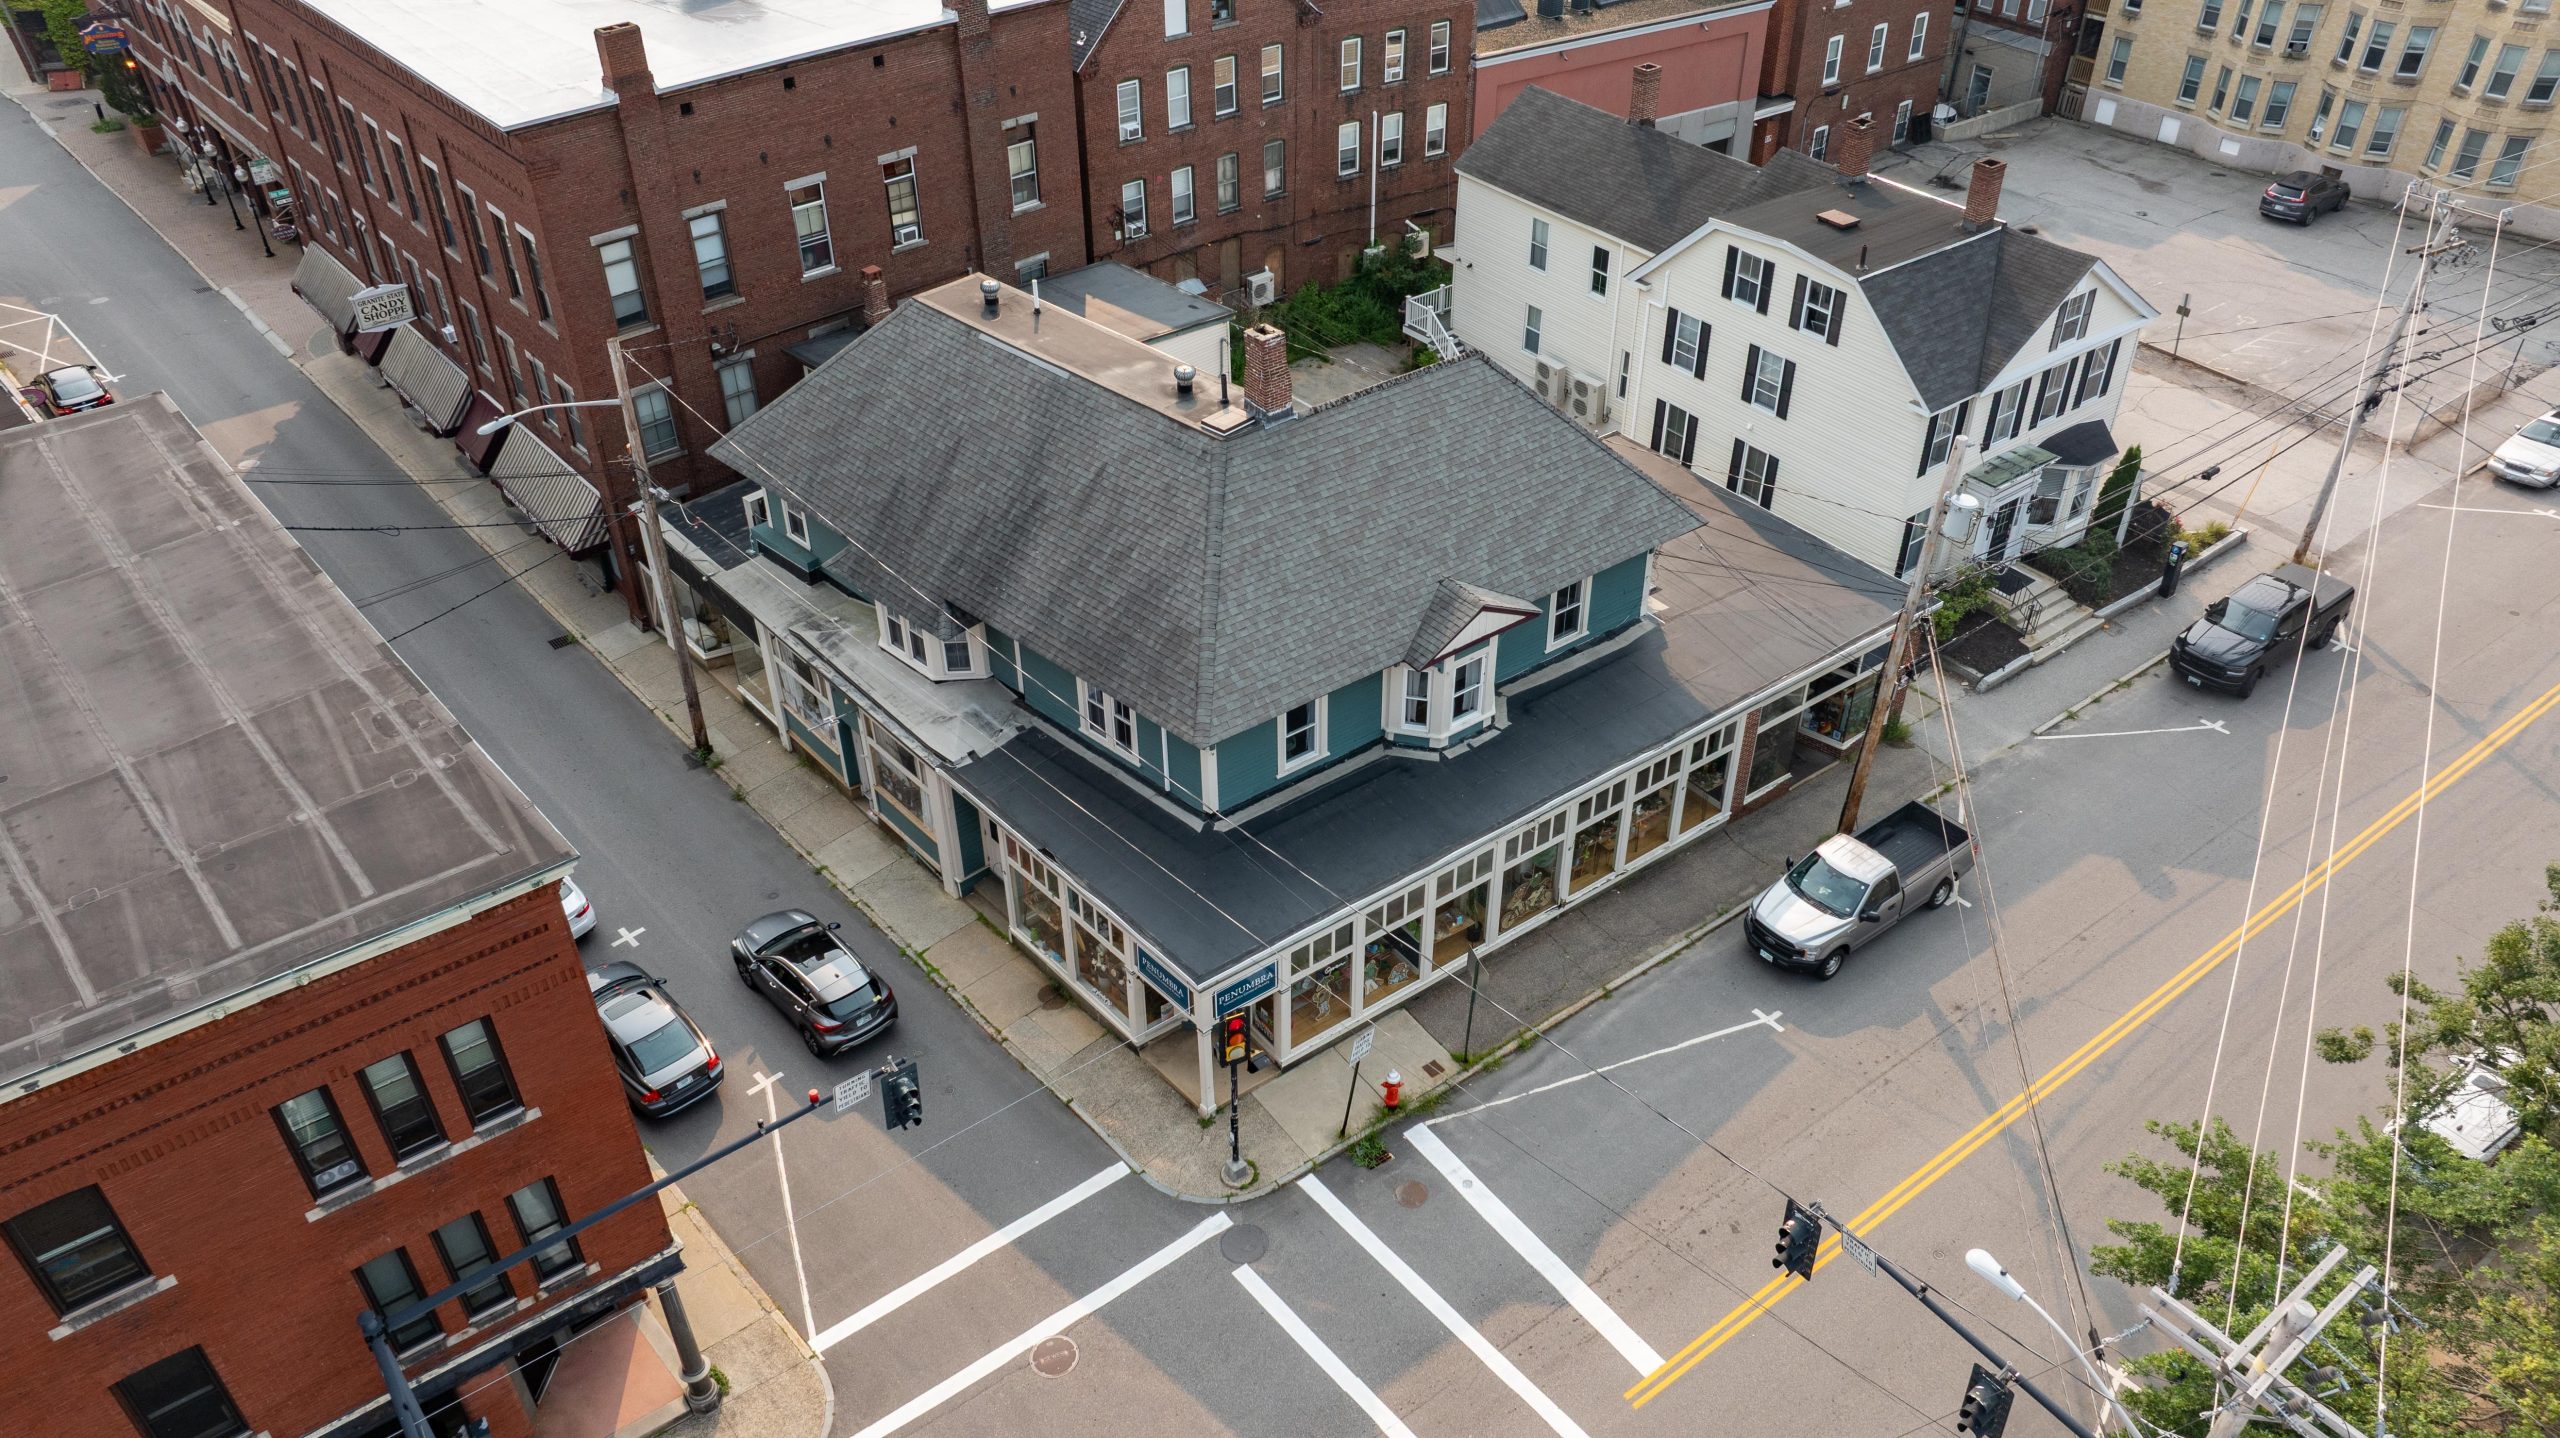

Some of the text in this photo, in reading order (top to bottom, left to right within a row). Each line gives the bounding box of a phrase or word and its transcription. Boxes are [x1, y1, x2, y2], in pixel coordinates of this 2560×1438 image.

[357, 289, 405, 307] GRANITE STATE
[361, 297, 405, 315] CANDY
[364, 305, 408, 322] SHOPPE
[1142, 957, 1184, 998] PENUMBRA
[1218, 972, 1273, 1005] PENUMBRA
[839, 1074, 866, 1091] TURNING
[840, 1081, 865, 1096] TRAFFIC
[838, 1090, 870, 1109] PEDESTRIANS
[839, 1084, 868, 1102] YIELD TO
